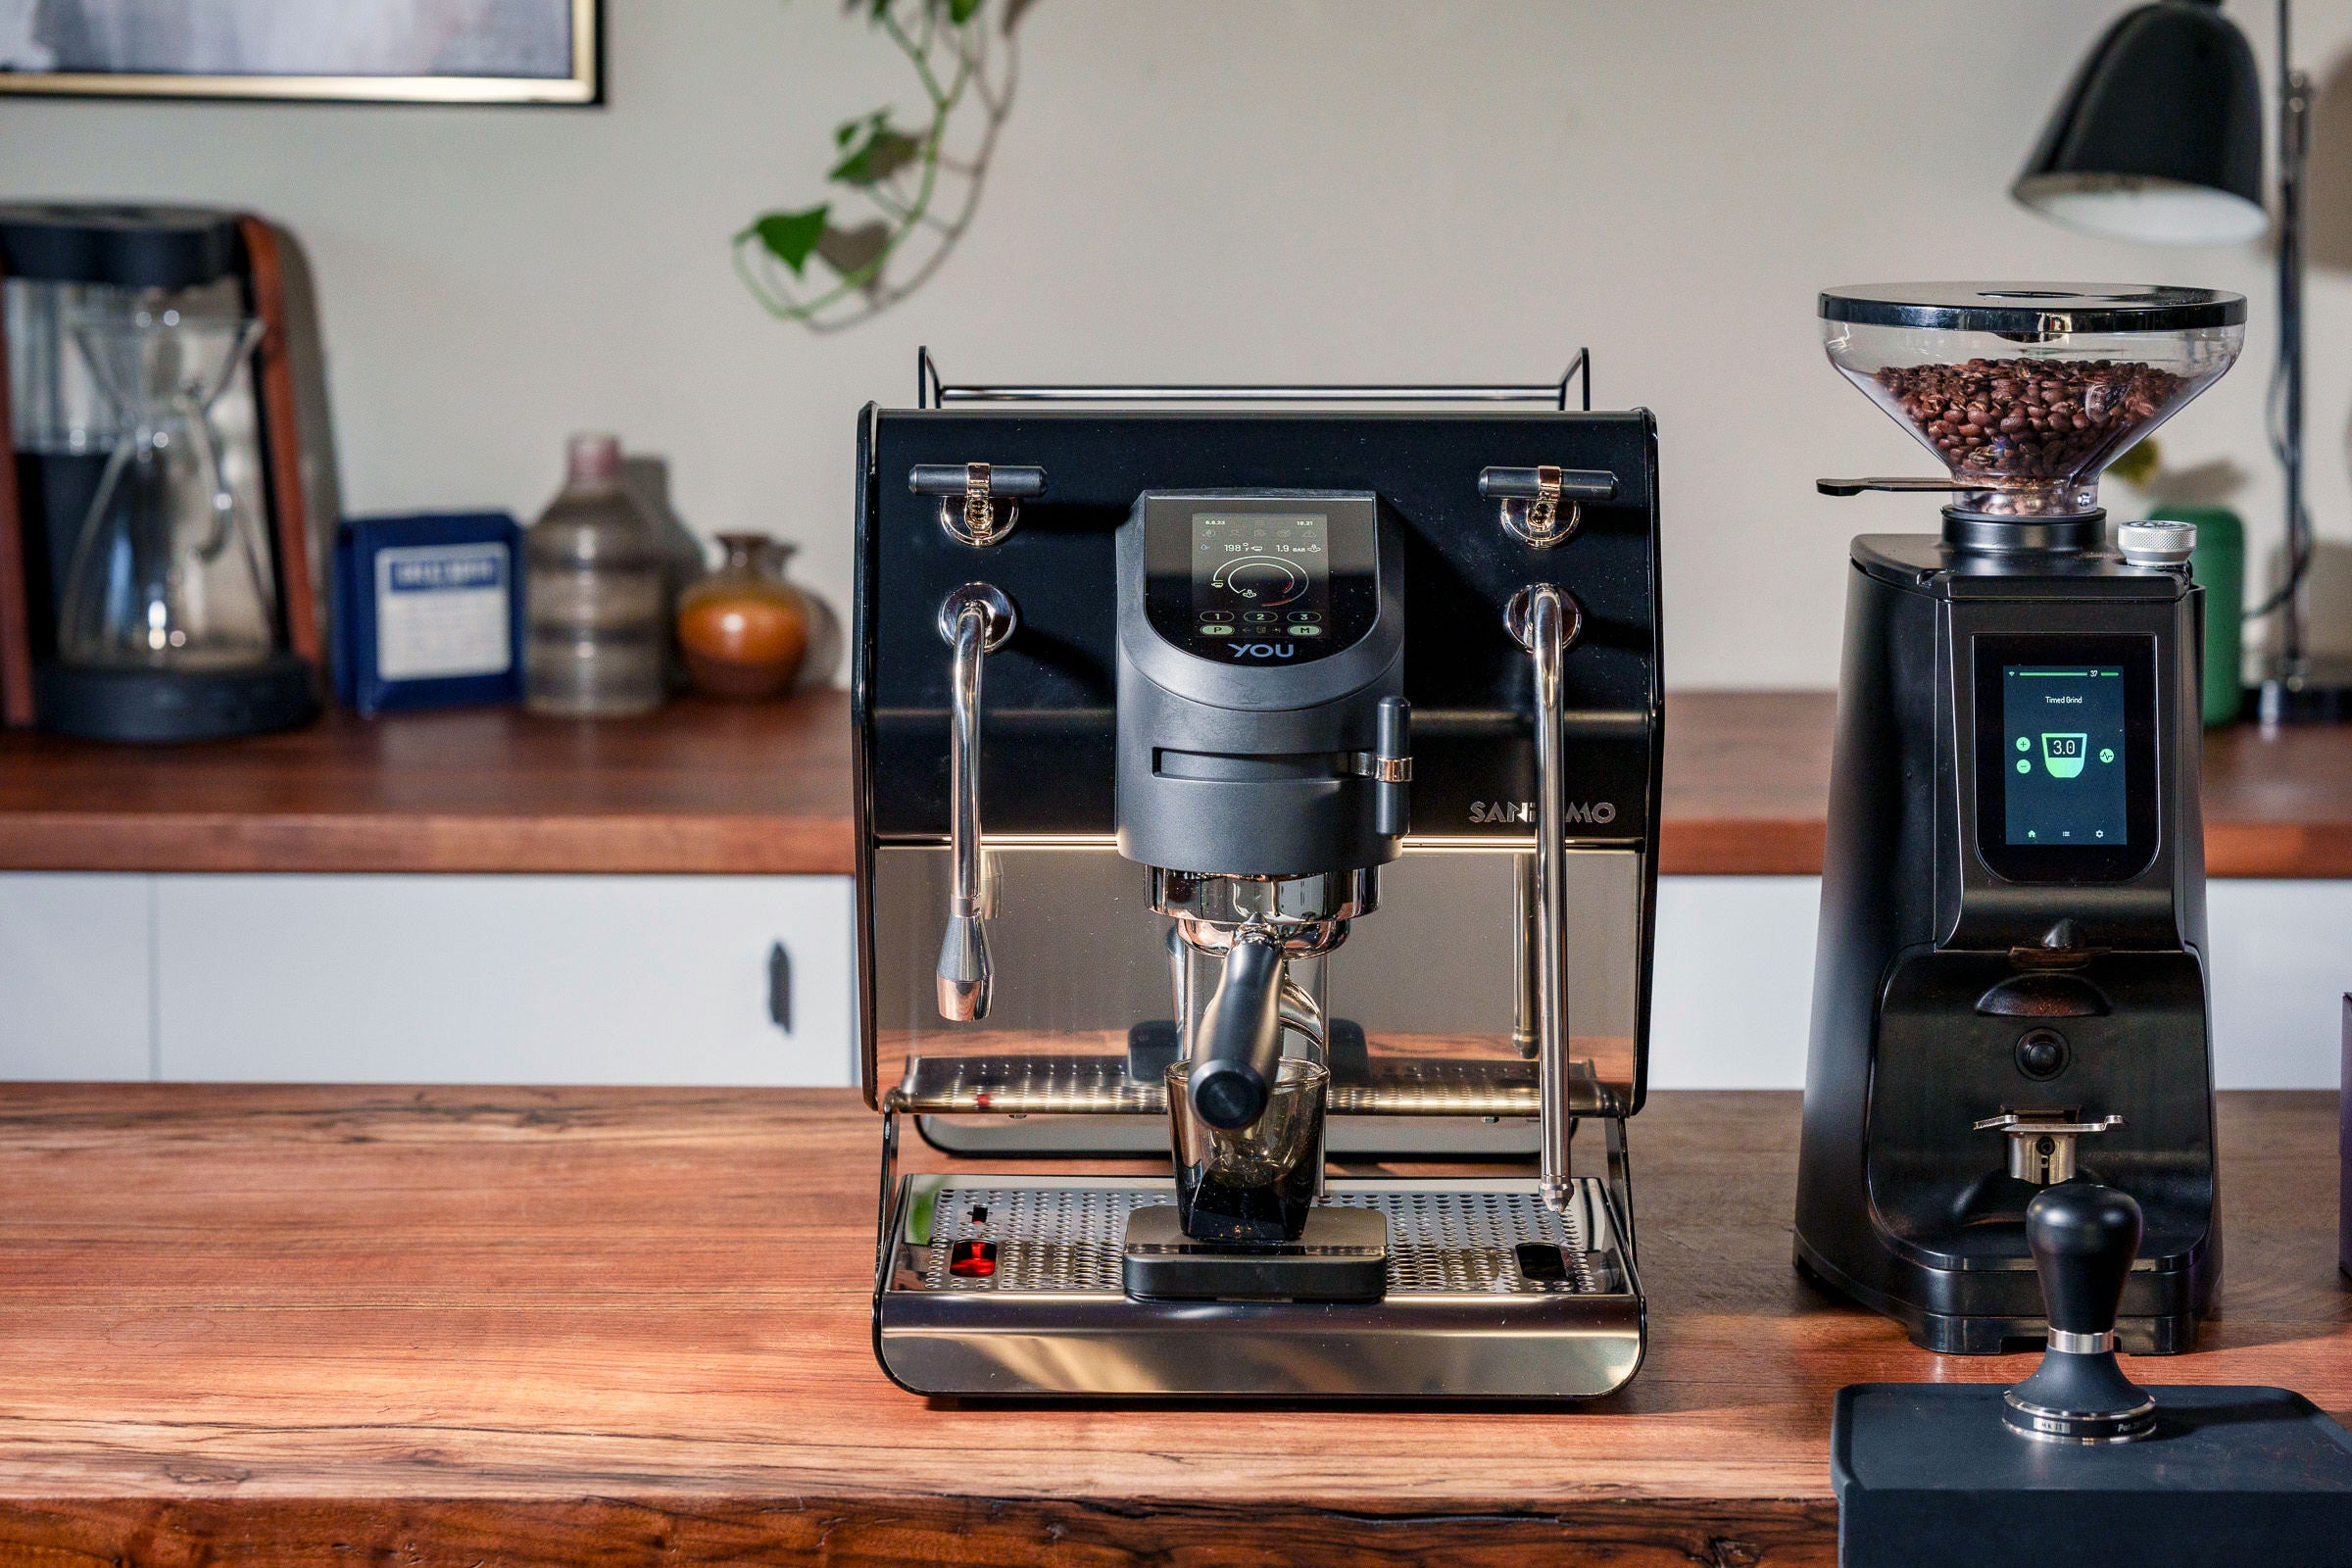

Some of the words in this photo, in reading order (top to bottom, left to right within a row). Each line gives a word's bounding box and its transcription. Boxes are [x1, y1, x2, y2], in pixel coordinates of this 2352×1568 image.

[1227, 643, 1295, 658] YOU
[2053, 740, 2076, 755] 3.0
[1468, 801, 1616, 824] SANMO
